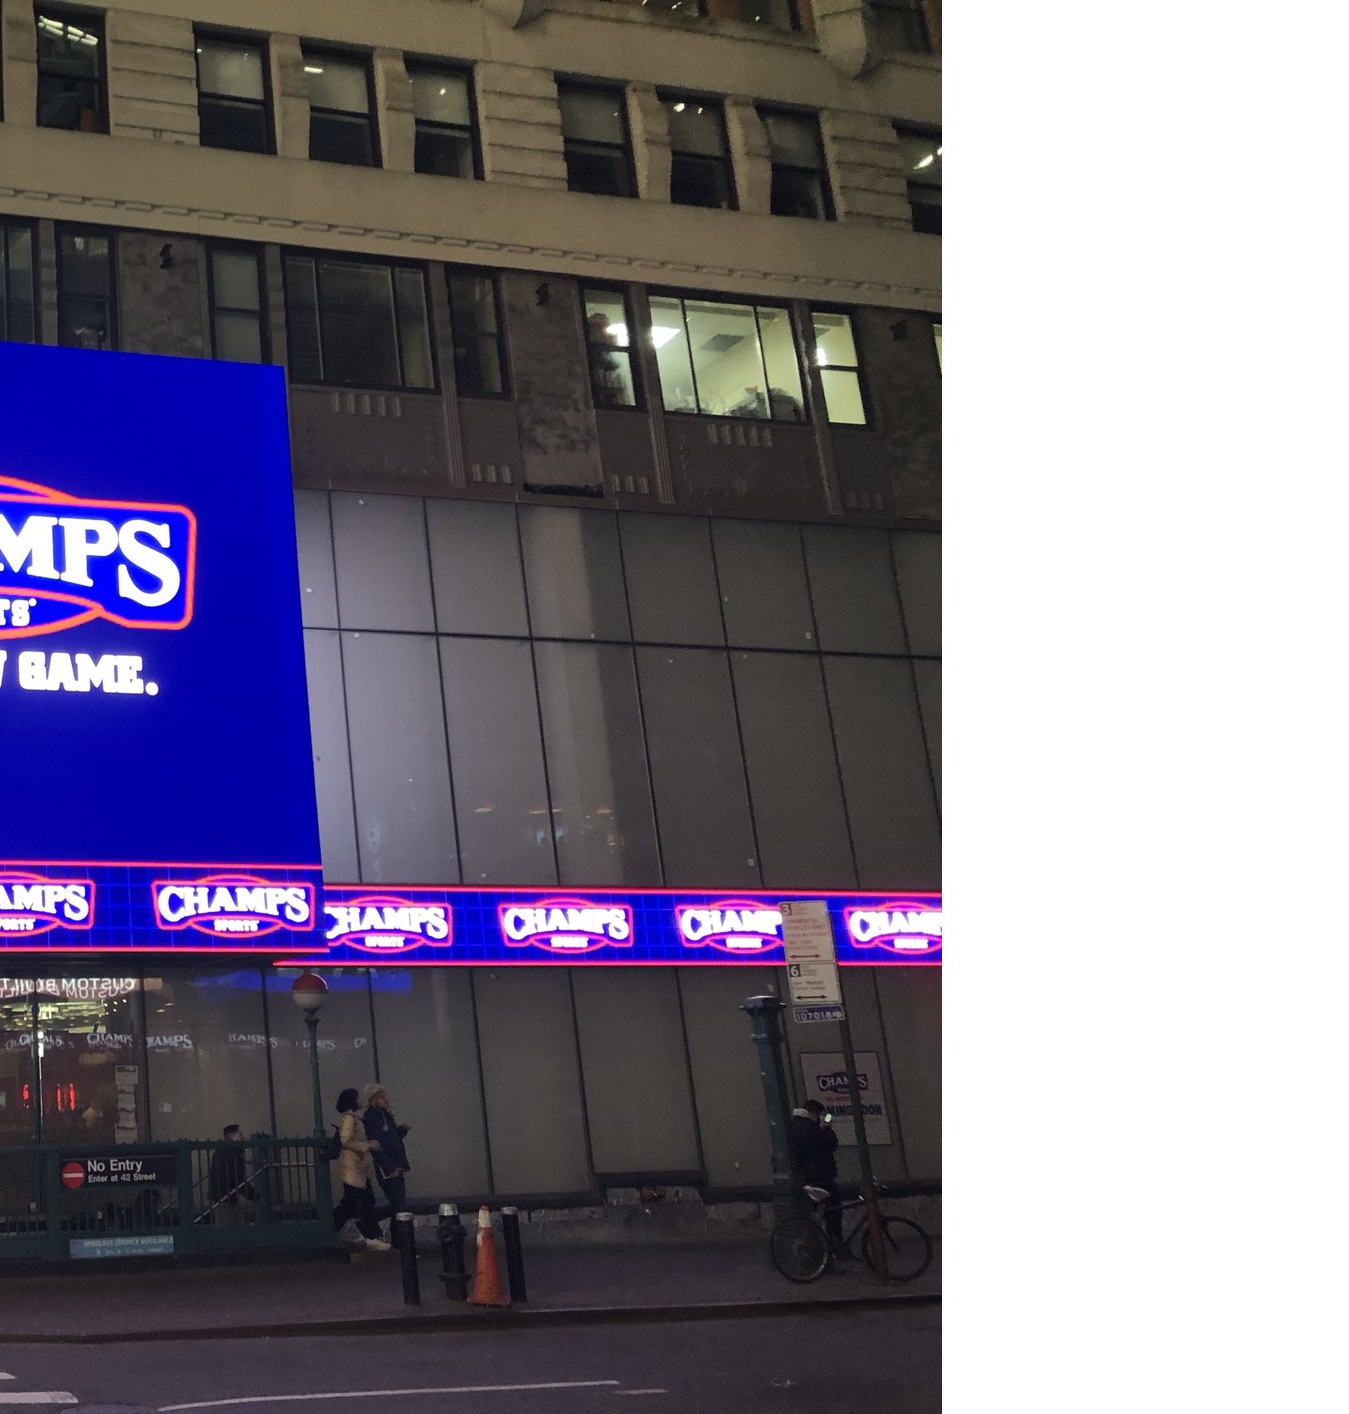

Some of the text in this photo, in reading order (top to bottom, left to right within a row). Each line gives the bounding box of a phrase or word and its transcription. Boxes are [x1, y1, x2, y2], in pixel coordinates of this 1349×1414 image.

[18, 651, 159, 696] GAME.
[158, 886, 310, 922] CHAMPS
[782, 904, 790, 914] 3
[214, 920, 259, 932] SPORTS
[504, 908, 629, 940] CHAMPS
[681, 909, 782, 941] CHAMP
[790, 965, 799, 976] 6
[87, 1159, 142, 1173] No Entry
[88, 1174, 107, 1183] Enter
[110, 1174, 118, 1182] at
[133, 1172, 156, 1181] Street
